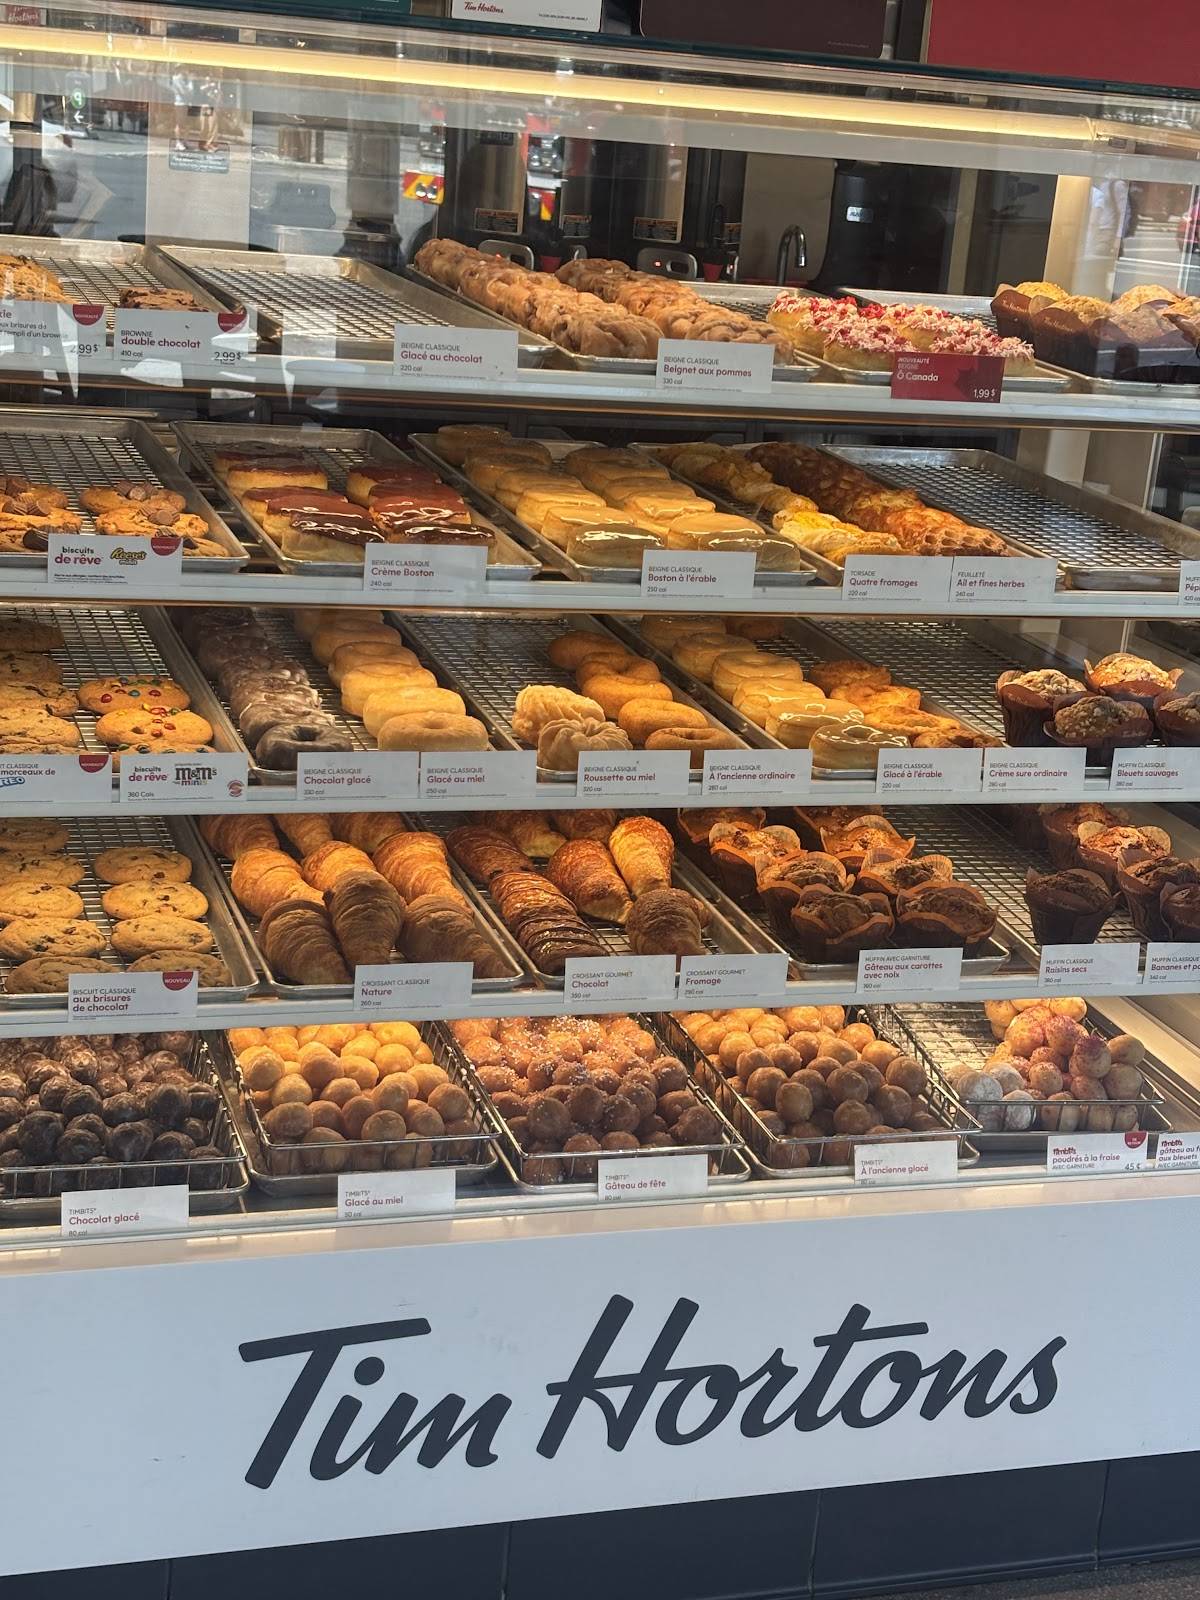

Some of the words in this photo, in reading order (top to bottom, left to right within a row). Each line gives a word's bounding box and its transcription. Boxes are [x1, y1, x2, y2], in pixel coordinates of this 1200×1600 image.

[122, 337, 156, 346] double
[158, 339, 200, 348] chocolat
[401, 342, 424, 350] BEIGNE
[425, 343, 460, 352] CLASSIQUE
[400, 350, 427, 360] Glacé
[444, 354, 482, 364] chocolat
[686, 357, 720, 365] CLASSIQUE
[664, 365, 696, 375] Beignet
[716, 368, 752, 377] pommes
[905, 372, 938, 382] Canada
[62, 546, 94, 554] biscuits
[54, 554, 71, 564] de
[74, 554, 102, 565] rêve
[372, 567, 401, 576] Crème
[404, 568, 434, 577] Boston
[670, 566, 702, 574] CLASSIQUE
[648, 574, 676, 582] Boston
[678, 574, 684, 582] à
[686, 574, 717, 583] l'érable
[850, 578, 878, 586] Quatre
[880, 578, 918, 588] fromages
[957, 579, 968, 587] Ail
[978, 579, 997, 587] fines
[998, 580, 1025, 588] herbes
[128, 773, 142, 782] de
[144, 772, 168, 782] rêve
[584, 774, 624, 782] Roussette
[710, 772, 716, 780] À
[717, 772, 757, 780] l'ancienne
[758, 772, 796, 780] ordinaire
[884, 770, 905, 778] Glacé
[906, 770, 912, 778] à
[914, 770, 942, 778] l'érable
[1145, 770, 1178, 778] sauvages
[304, 776, 344, 784] Chocolat
[346, 775, 372, 786] glacé
[427, 775, 452, 784] Glacé
[467, 775, 485, 783] miel
[864, 963, 894, 971] Gâteau
[911, 962, 943, 970] carottes
[1046, 966, 1070, 974] Raisins
[572, 980, 609, 988] Chocolat
[686, 978, 722, 986] Fromage
[72, 988, 98, 996] BISCUIT
[362, 988, 392, 996] Nature
[94, 994, 132, 1002] brisures
[73, 1004, 85, 1012] de
[88, 1003, 128, 1012] chocolat
[1160, 1148, 1184, 1156] gâteau
[1052, 1155, 1082, 1164] poudrés
[1084, 1154, 1089, 1162] à
[1090, 1154, 1098, 1162] la
[861, 1166, 867, 1175] À
[868, 1166, 907, 1174] l'ancienne
[908, 1164, 929, 1174] glacé
[605, 1181, 636, 1190] Gâteau
[638, 1180, 648, 1188] de
[650, 1180, 666, 1188] fête
[345, 1198, 370, 1207] Glacé
[386, 1196, 404, 1204] miel
[69, 1215, 112, 1225] Chocolat
[114, 1212, 140, 1224] glacé
[238, 1317, 512, 1490] Tim
[536, 1294, 1066, 1459] Hortons
